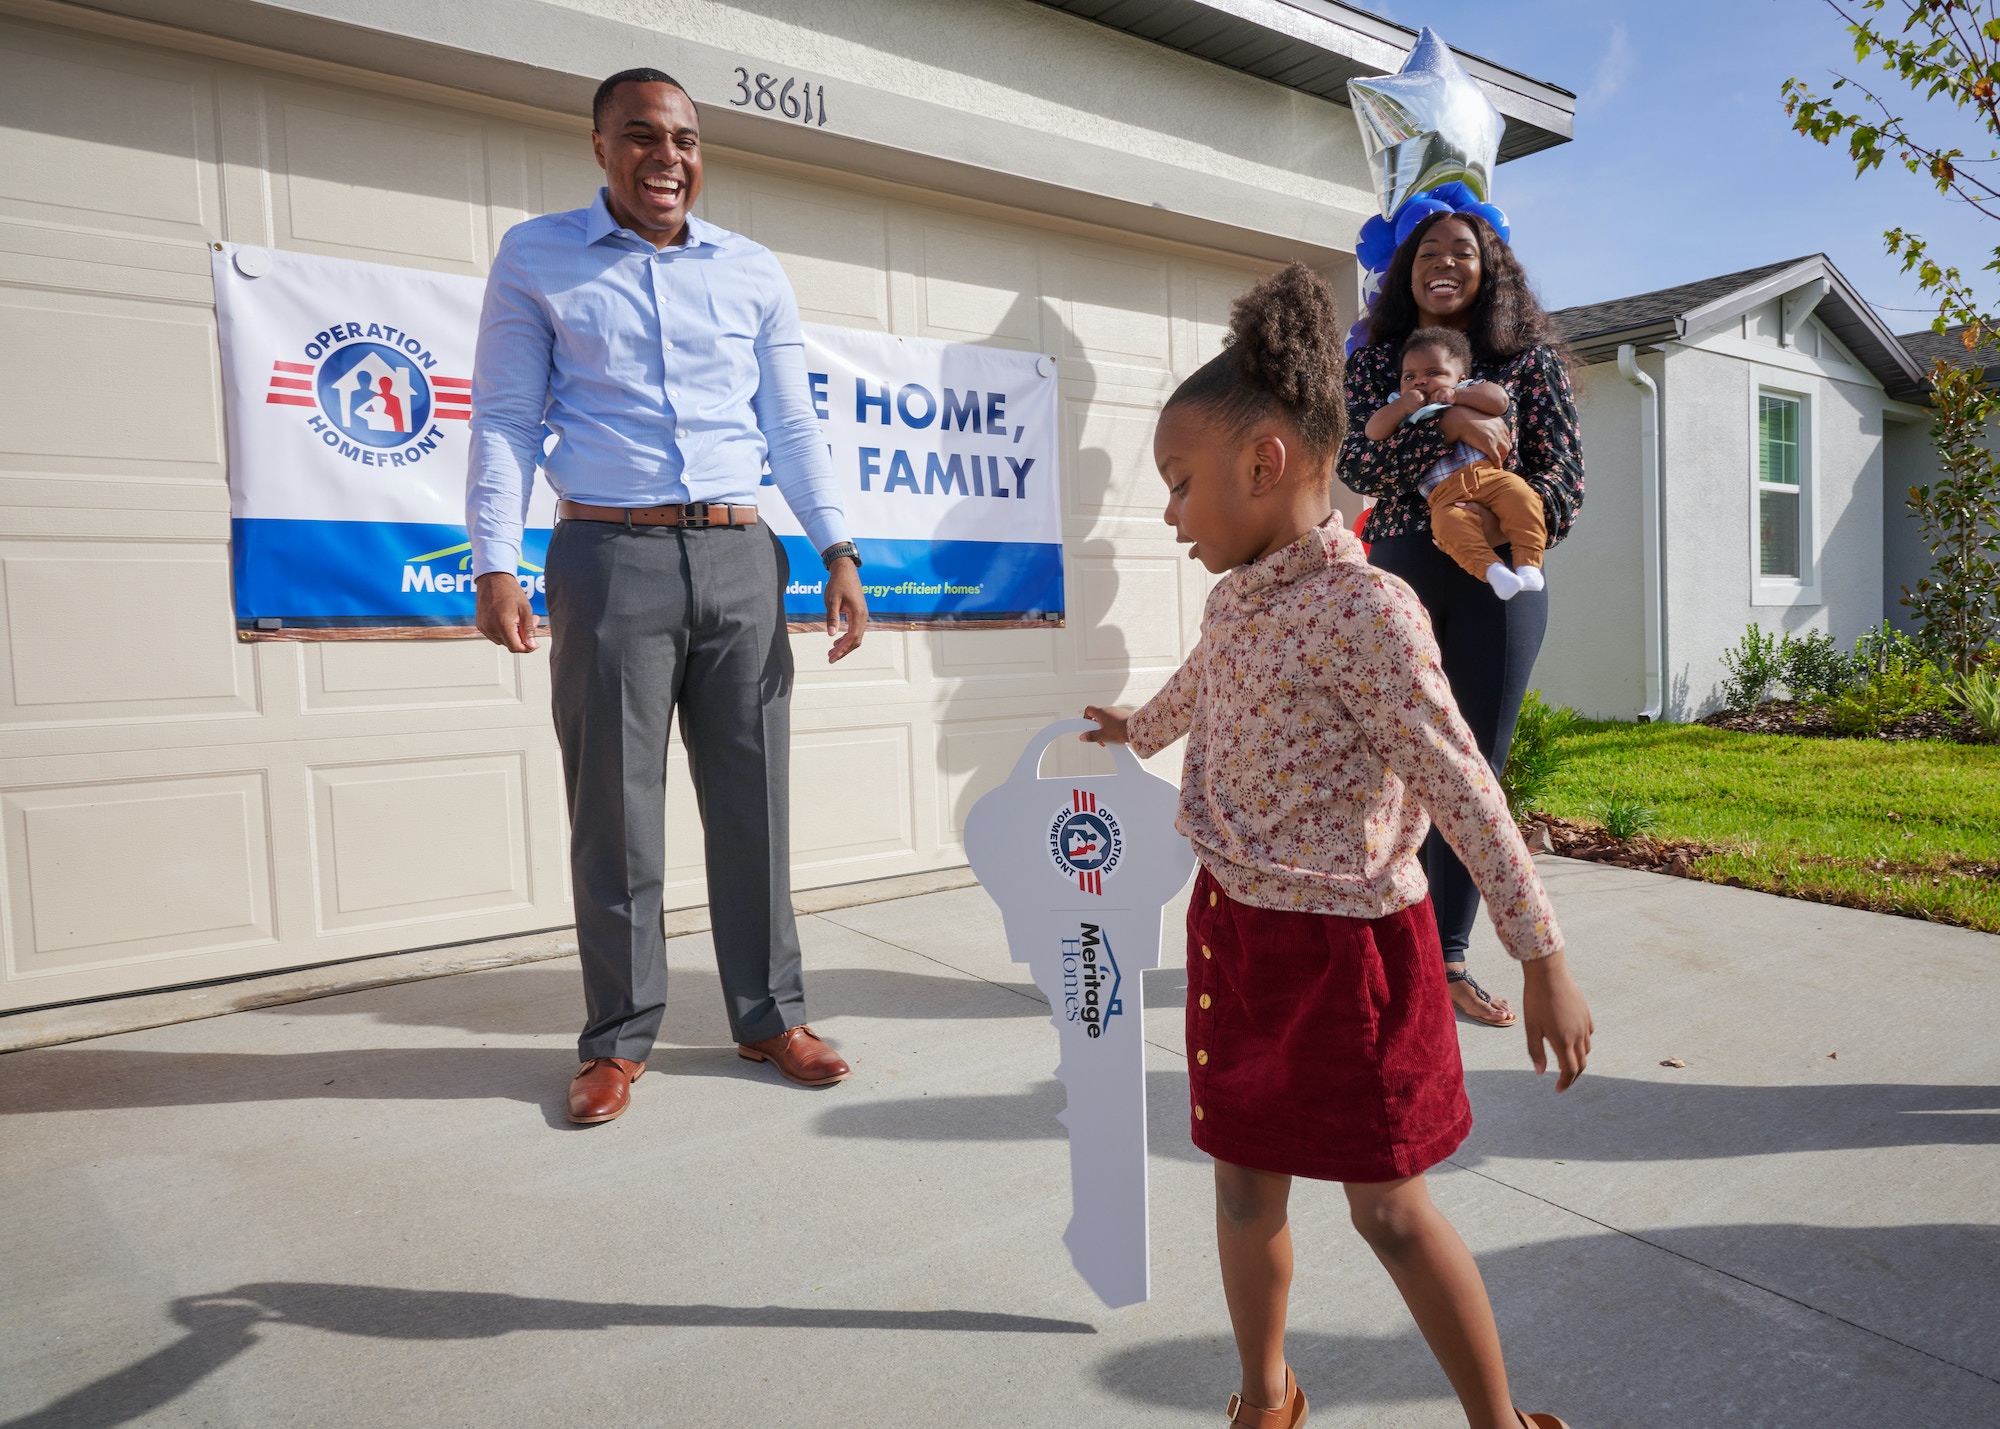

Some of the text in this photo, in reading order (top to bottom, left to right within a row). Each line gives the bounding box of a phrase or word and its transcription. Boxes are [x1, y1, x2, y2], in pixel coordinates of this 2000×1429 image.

[730, 66, 827, 126] 38611
[304, 321, 438, 370] OPERATION
[855, 377, 1025, 444] HOME,
[307, 414, 445, 468] HOMEFRONT
[858, 446, 1036, 499] FAMILY
[401, 563, 546, 600] Merige
[862, 581, 942, 598] ergy-efficient
[1050, 807, 1076, 878] HOMEFRONT
[1098, 808, 1122, 875] OPERATION
[1061, 937, 1081, 1022] Homes
[1080, 922, 1105, 1039] Meritage
